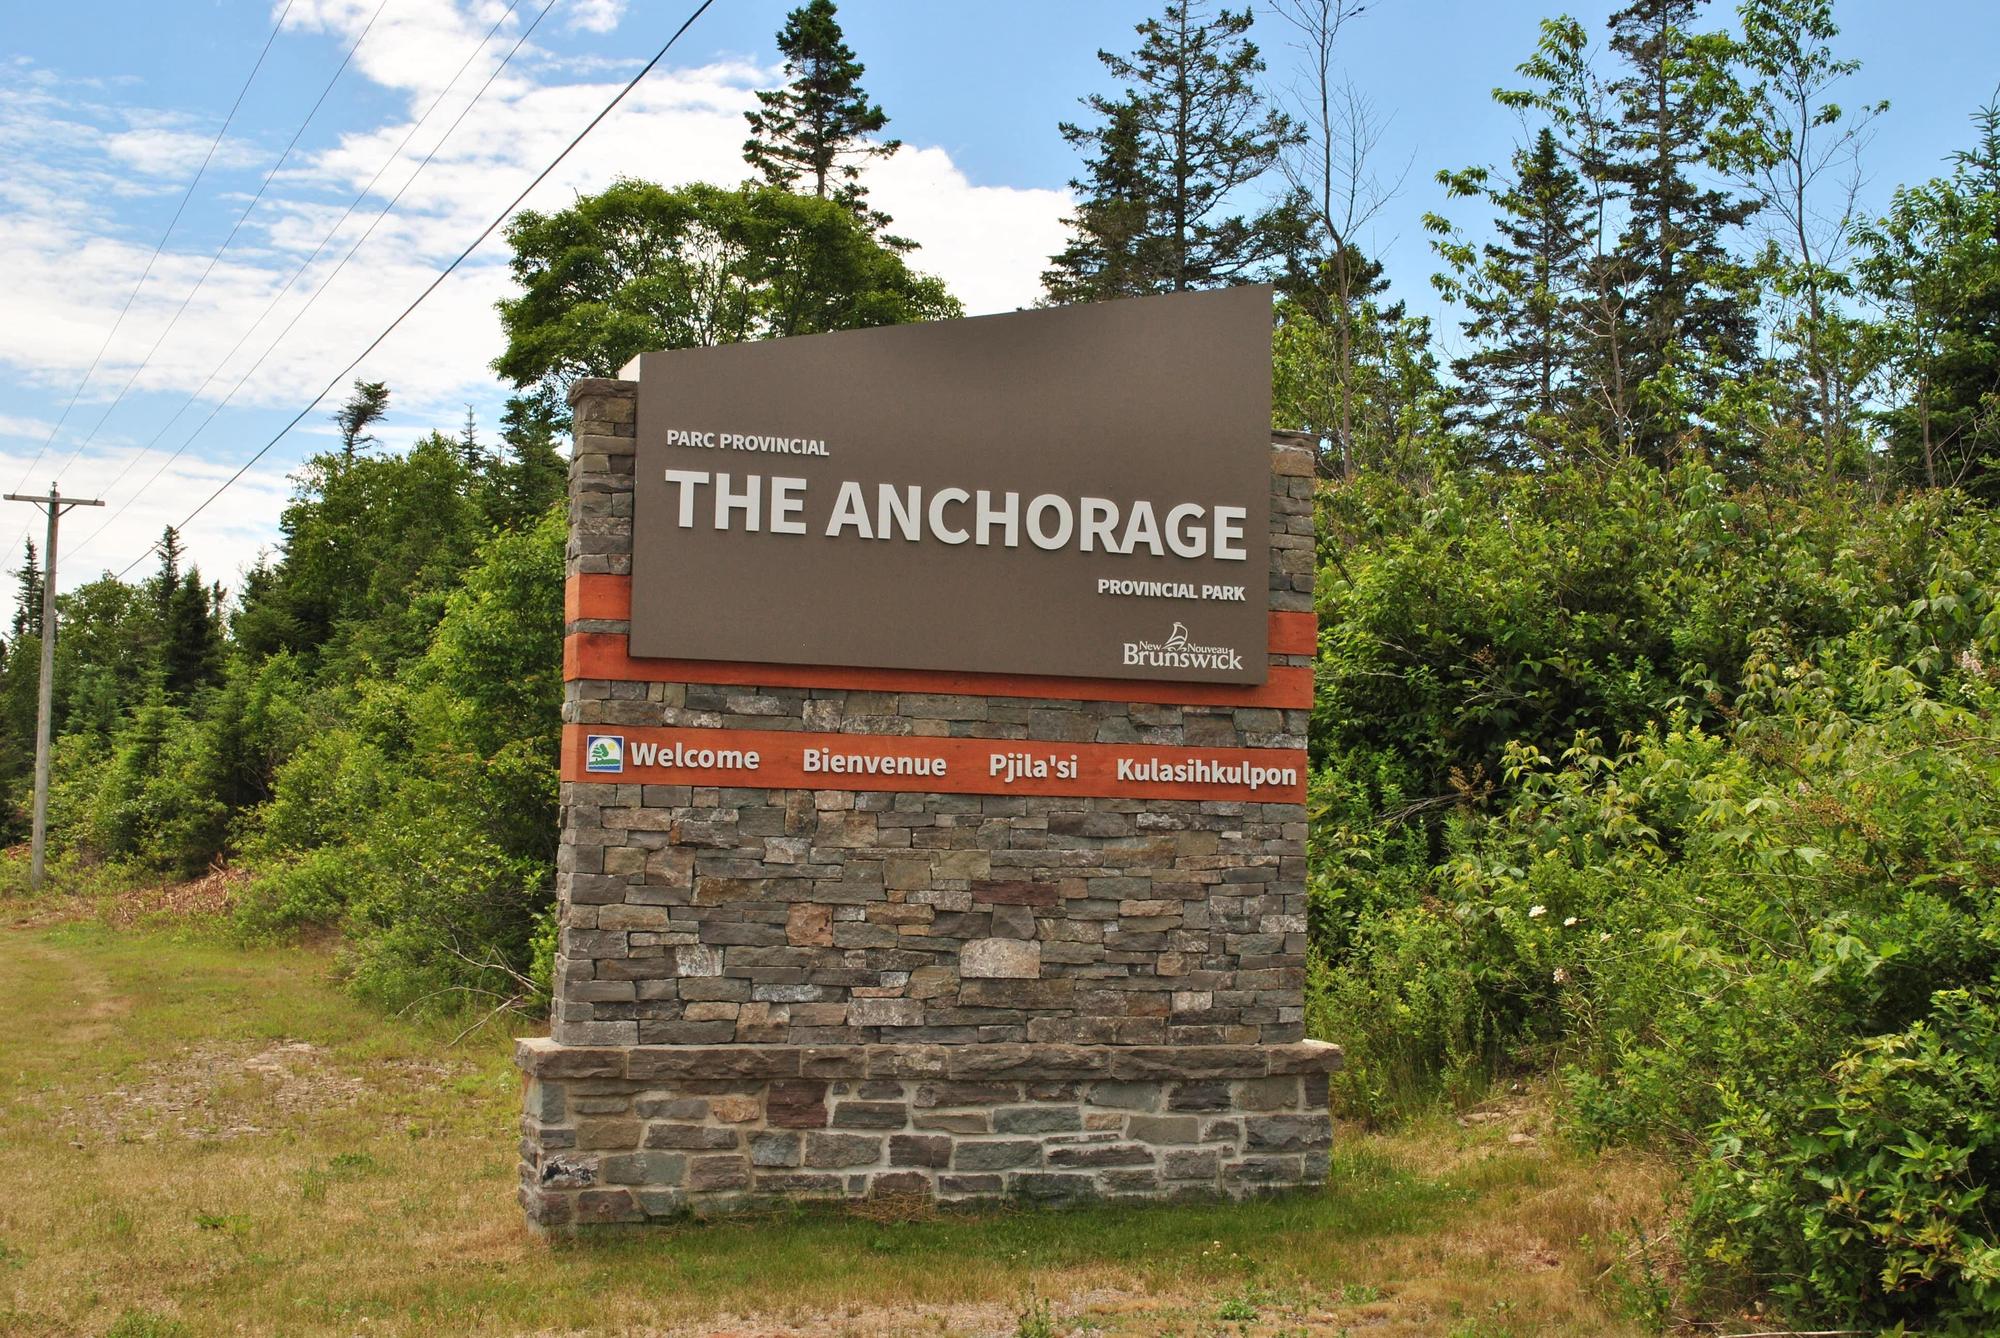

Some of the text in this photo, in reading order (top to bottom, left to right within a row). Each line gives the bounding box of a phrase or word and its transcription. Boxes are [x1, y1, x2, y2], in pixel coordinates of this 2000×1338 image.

[666, 429, 830, 456] PARC PROVINCIAL
[665, 469, 1247, 561] THE ANCHORAGE
[1097, 578, 1246, 601] PROVINCIAL PARK
[1123, 642, 1243, 670] Brunswick
[1139, 640, 1228, 654] New Nouveau
[630, 742, 1297, 790] Welcome Bienvenue Pjila'si Kulasihkulpon
